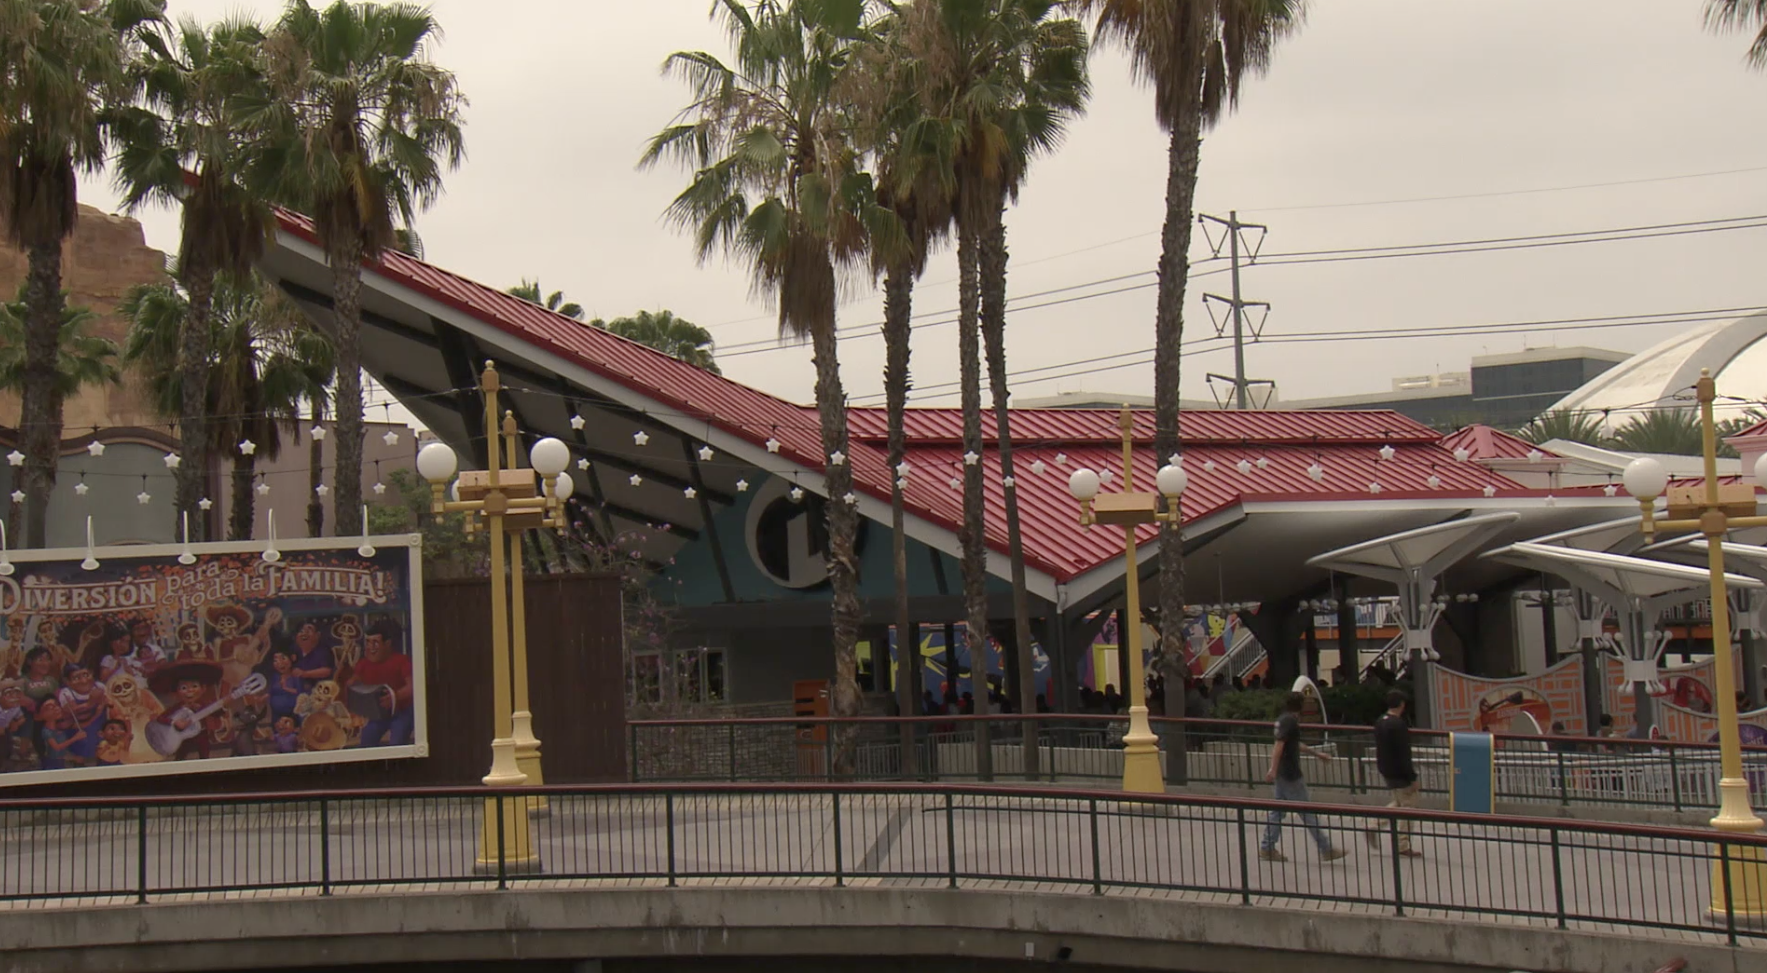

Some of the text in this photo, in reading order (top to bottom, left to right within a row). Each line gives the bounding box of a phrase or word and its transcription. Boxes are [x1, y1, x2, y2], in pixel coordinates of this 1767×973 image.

[0, 561, 386, 615] DIVERSIÓN para toda la FAMILIA!
